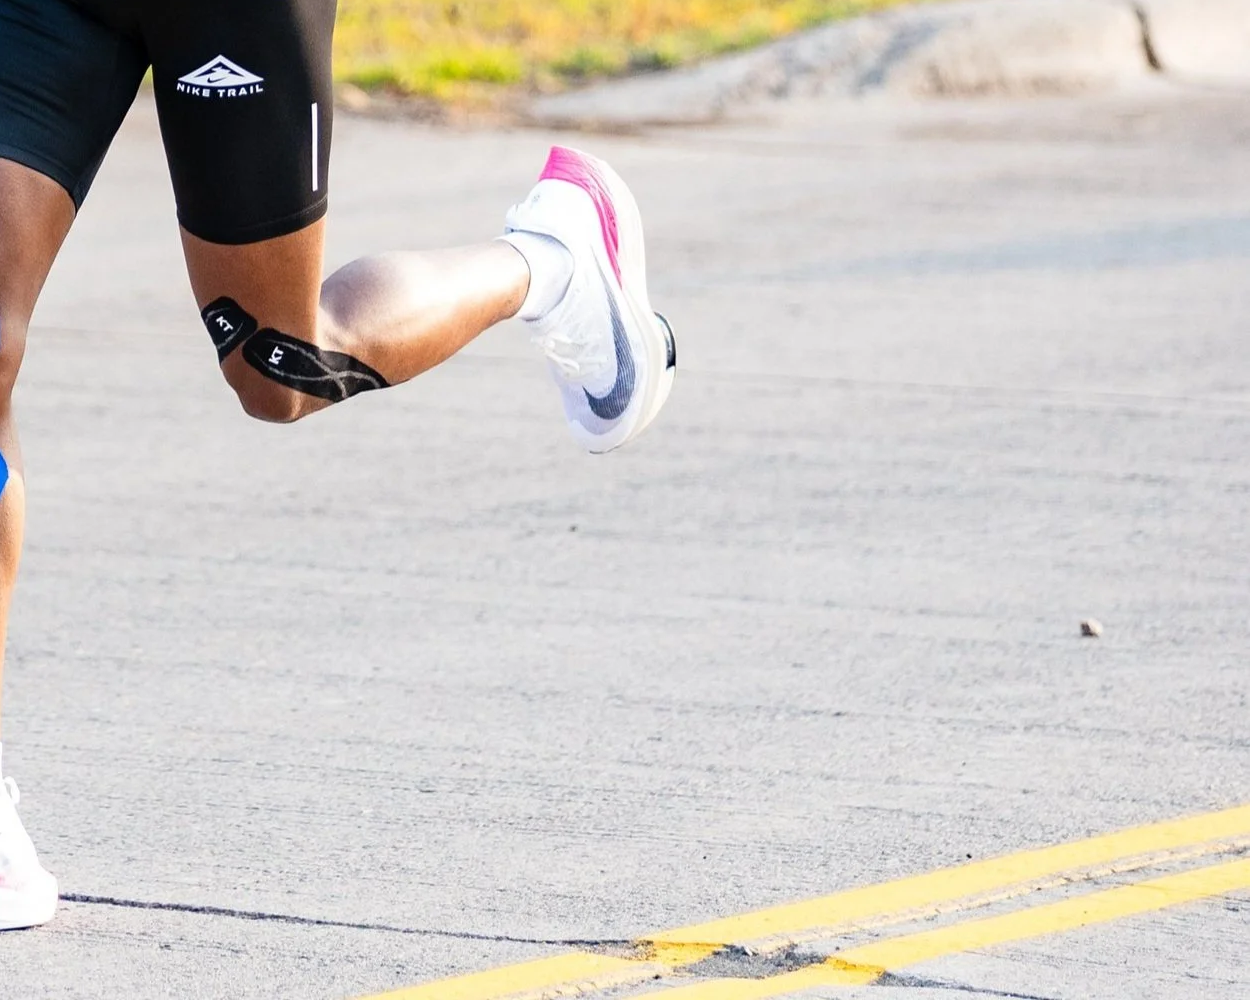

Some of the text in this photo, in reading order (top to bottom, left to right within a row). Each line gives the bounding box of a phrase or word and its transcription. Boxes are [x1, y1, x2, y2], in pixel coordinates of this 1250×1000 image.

[176, 82, 264, 98] NIKE TRAIL
[215, 315, 234, 332] KT
[268, 345, 285, 366] KT
